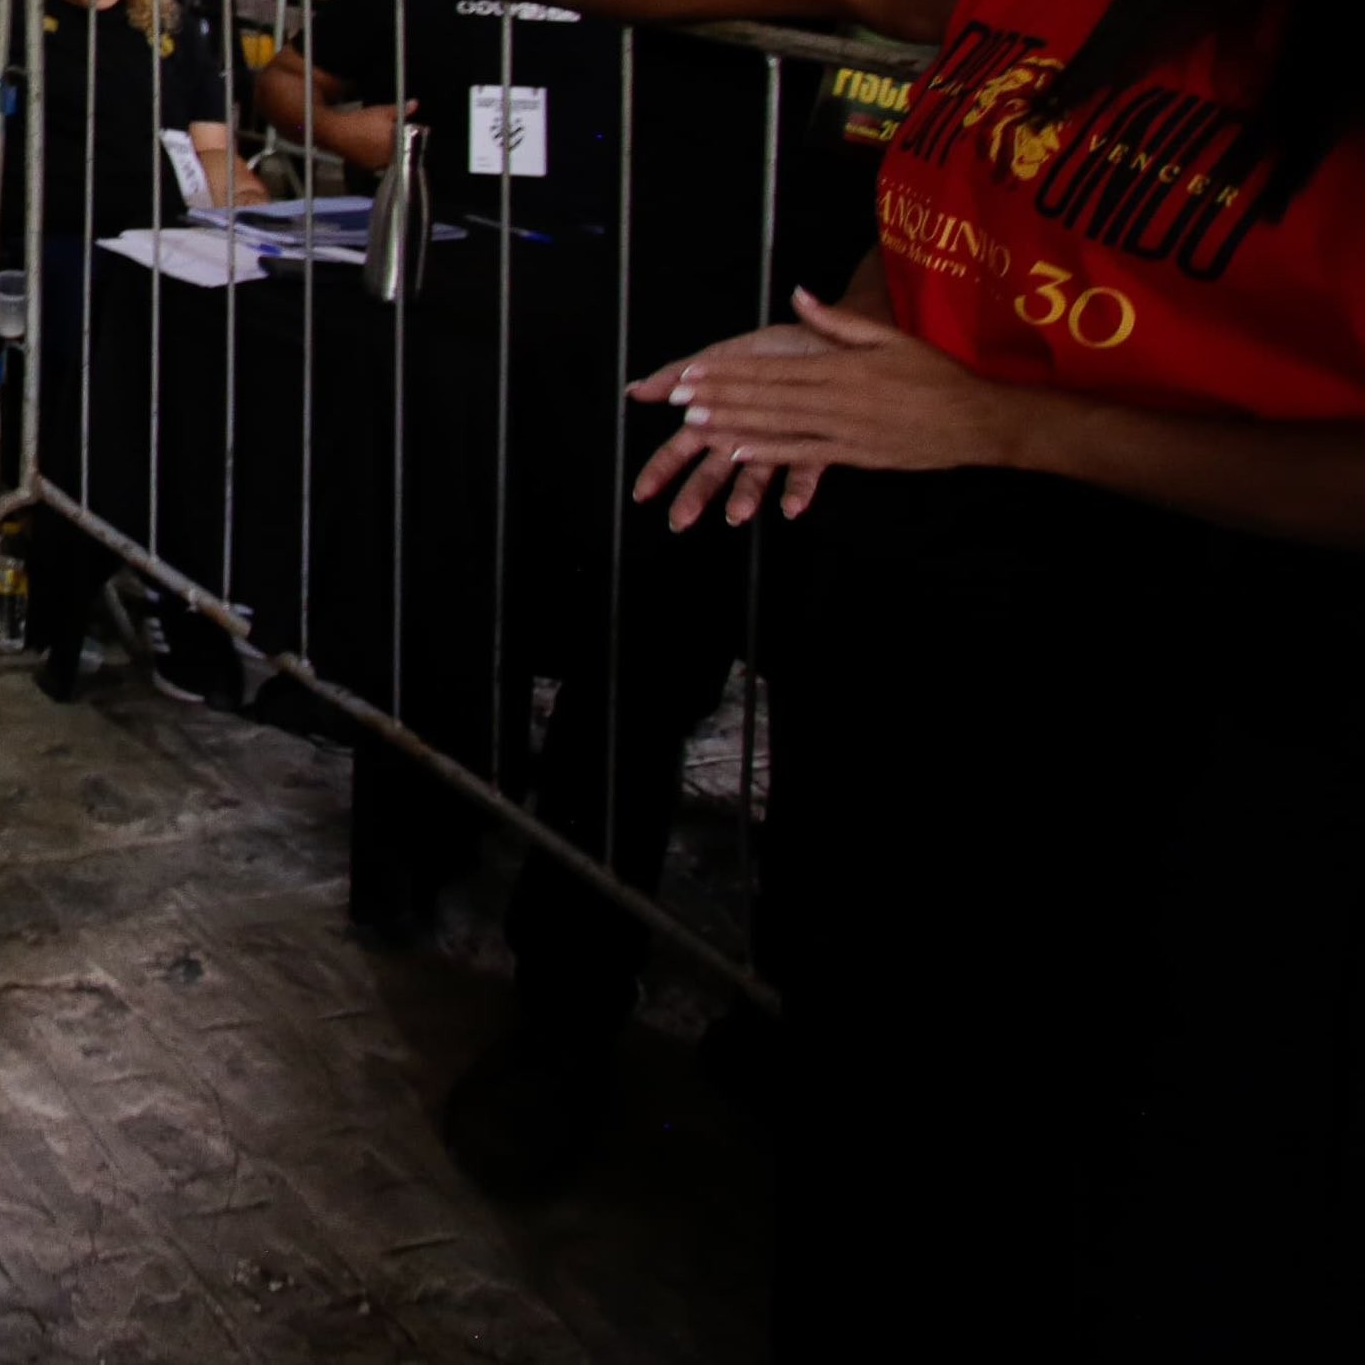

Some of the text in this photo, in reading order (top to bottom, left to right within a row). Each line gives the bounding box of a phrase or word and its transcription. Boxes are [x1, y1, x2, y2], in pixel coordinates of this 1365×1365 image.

[1088, 134, 1240, 210] VENCER
[877, 190, 1012, 280] ANQUINHO
[1012, 259, 1137, 350] 30
